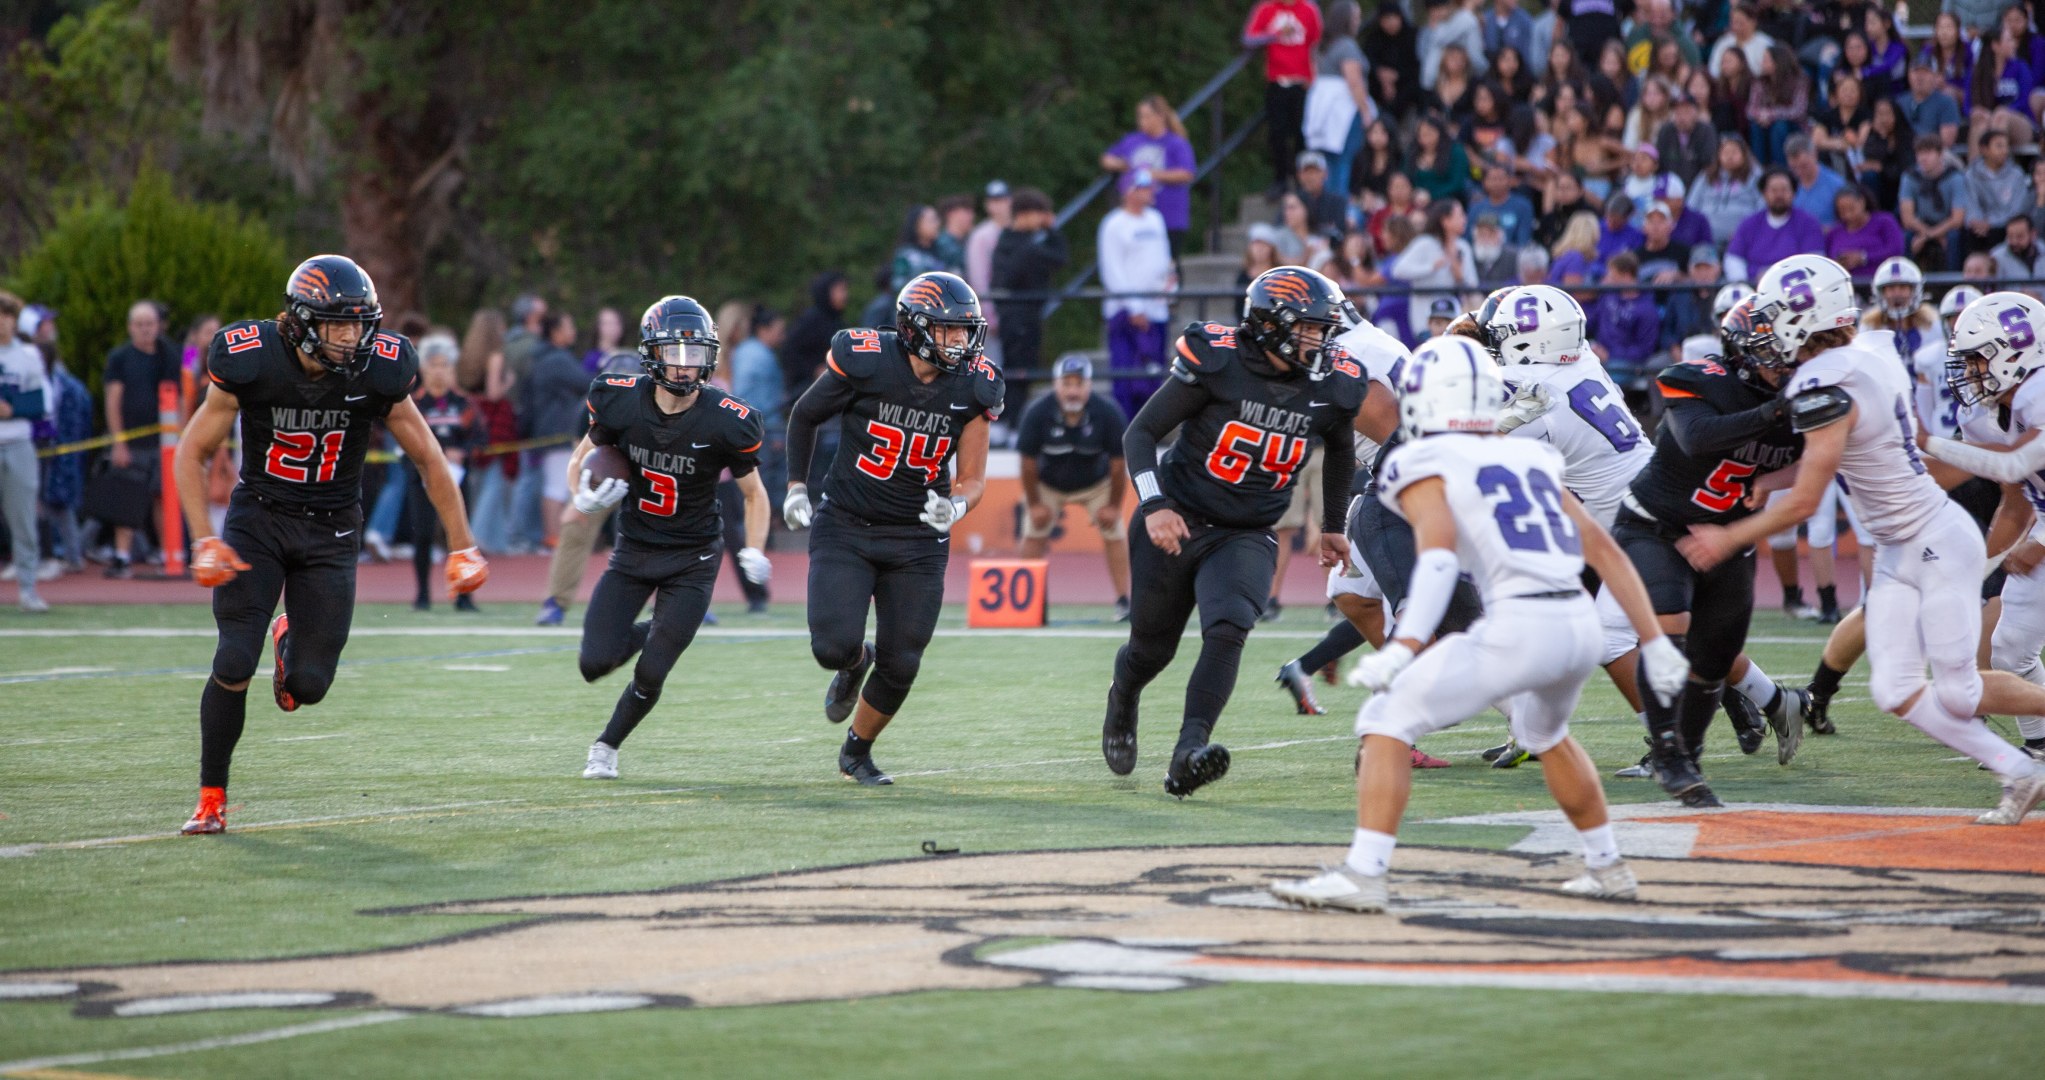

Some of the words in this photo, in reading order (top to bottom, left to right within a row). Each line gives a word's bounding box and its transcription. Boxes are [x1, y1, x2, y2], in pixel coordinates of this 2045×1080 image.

[1780, 268, 1816, 314] S
[1514, 296, 1539, 333] S
[1997, 306, 2036, 351] S
[225, 325, 262, 354] 21
[850, 329, 882, 354] 34
[1204, 323, 1238, 349] 64
[606, 377, 637, 388] 3
[272, 407, 351, 430] WILDCATS
[719, 397, 750, 420] 3
[879, 402, 952, 435] WILDCATS
[1240, 399, 1313, 436] WILDCATS
[1566, 378, 1644, 454] 6
[265, 430, 346, 483] 21
[629, 443, 696, 475] WILDCATS
[856, 419, 952, 486] 34
[1206, 420, 1308, 490] 64
[1733, 441, 1795, 468] WILDCATS
[639, 467, 679, 517] 3
[1477, 464, 1582, 557] 20
[979, 568, 1035, 612] 30
